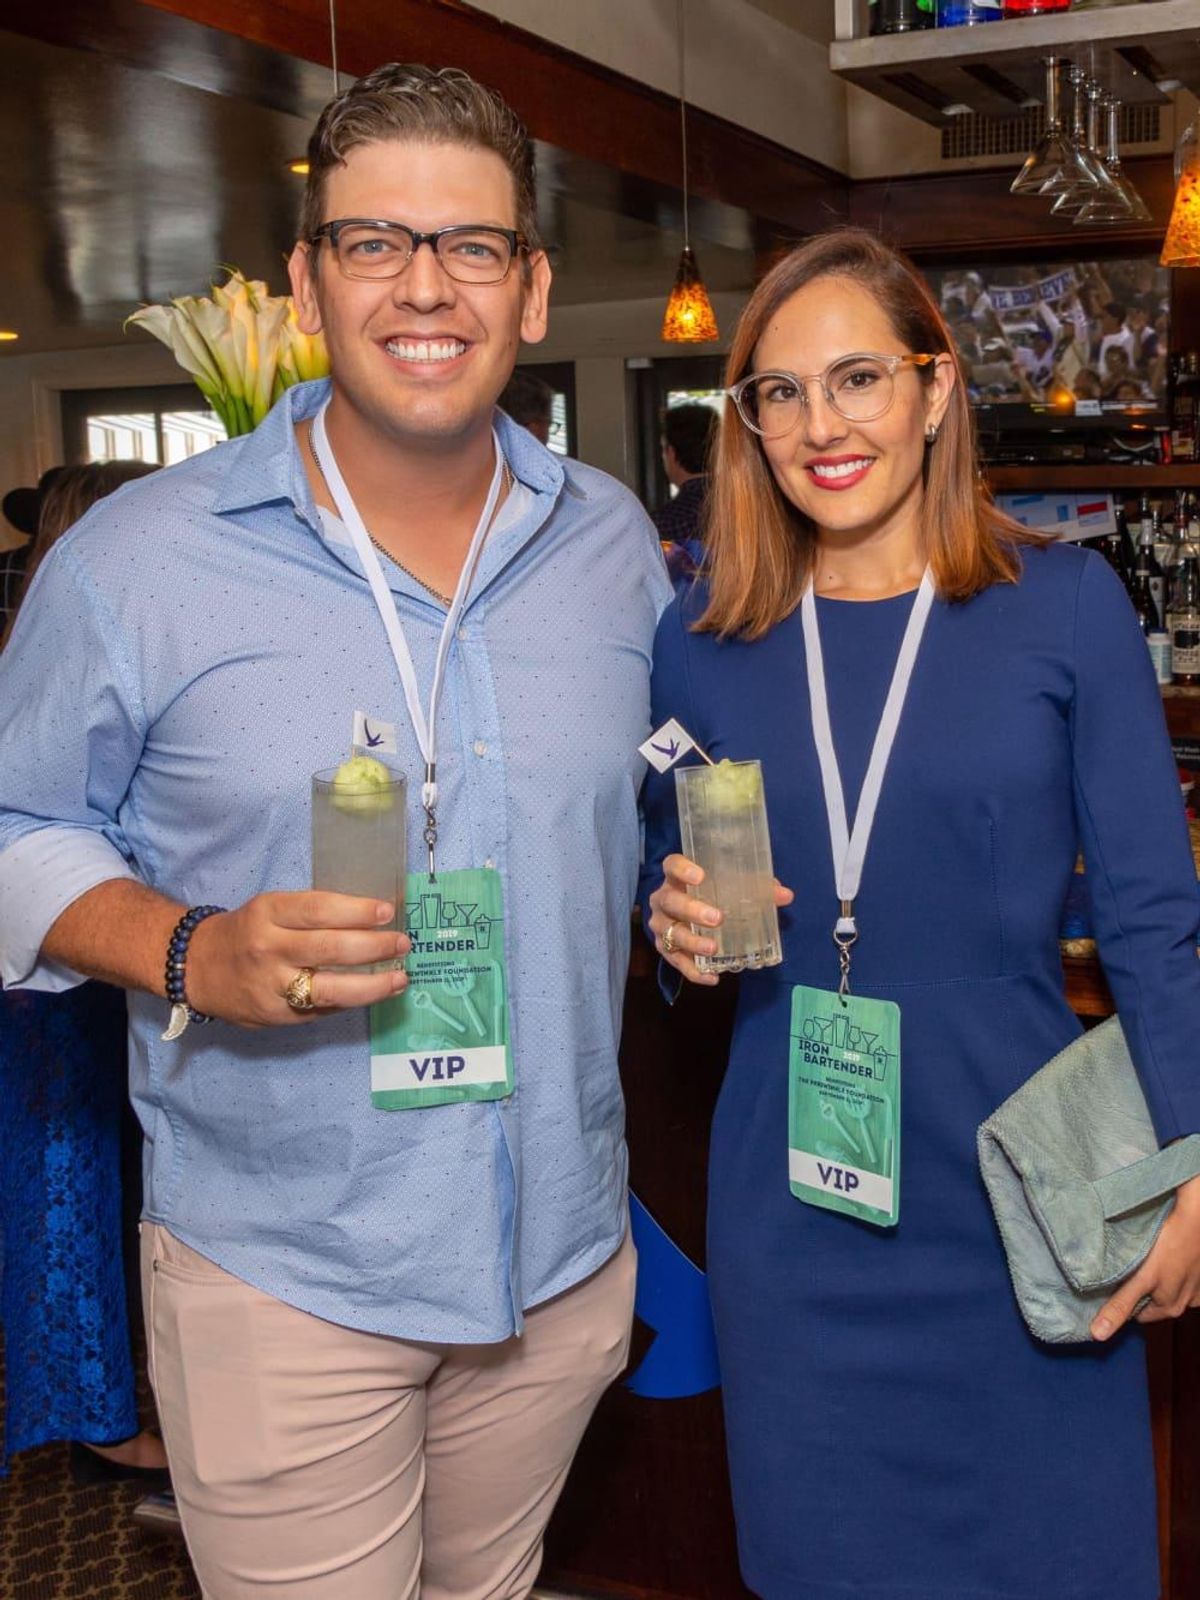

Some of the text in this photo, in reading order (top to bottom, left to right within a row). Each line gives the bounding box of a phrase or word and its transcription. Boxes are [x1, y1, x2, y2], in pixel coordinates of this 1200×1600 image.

[411, 939, 475, 953] RTENDER
[799, 1040, 829, 1055] IRON
[409, 1055, 466, 1082] VIP
[804, 1053, 873, 1079] BARTENDER
[817, 1162, 860, 1192] VIP
